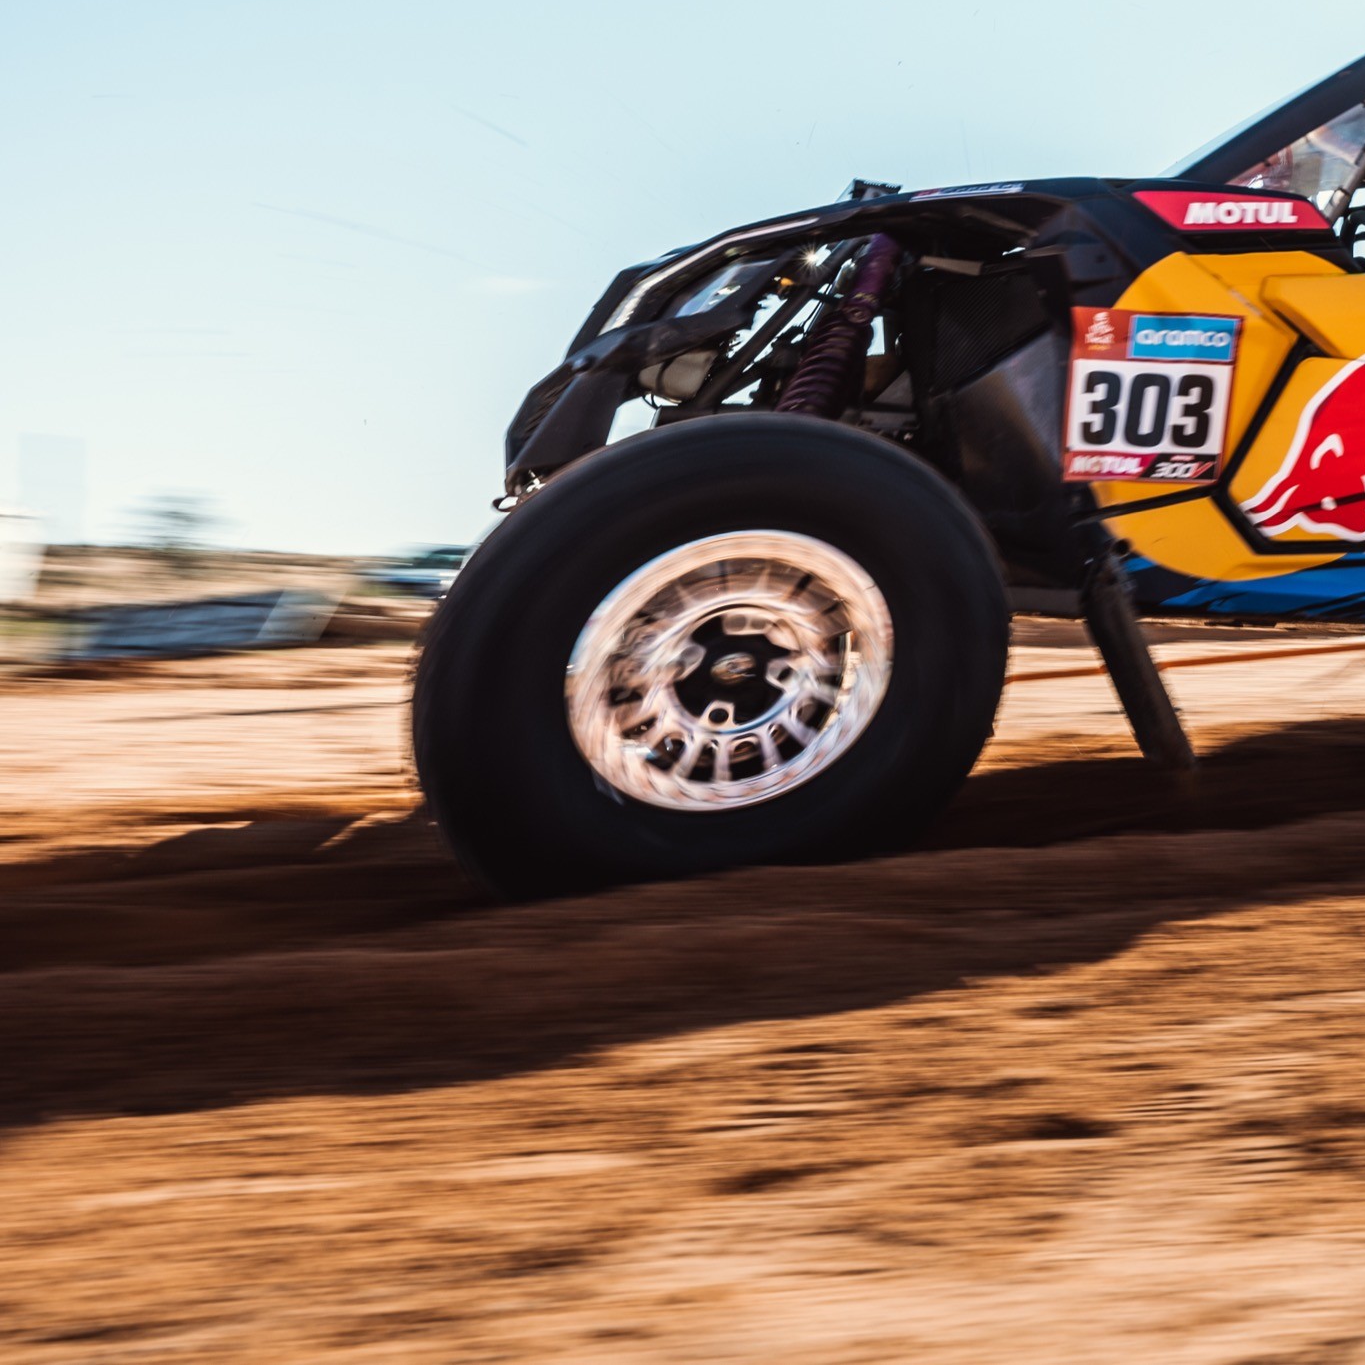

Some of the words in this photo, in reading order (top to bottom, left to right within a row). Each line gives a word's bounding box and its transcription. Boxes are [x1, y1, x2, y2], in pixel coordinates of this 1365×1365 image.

[1183, 202, 1298, 224] MOTUL
[1136, 329, 1231, 348] aramco
[1080, 370, 1214, 448] 303
[1069, 455, 1144, 474] MOTUL
